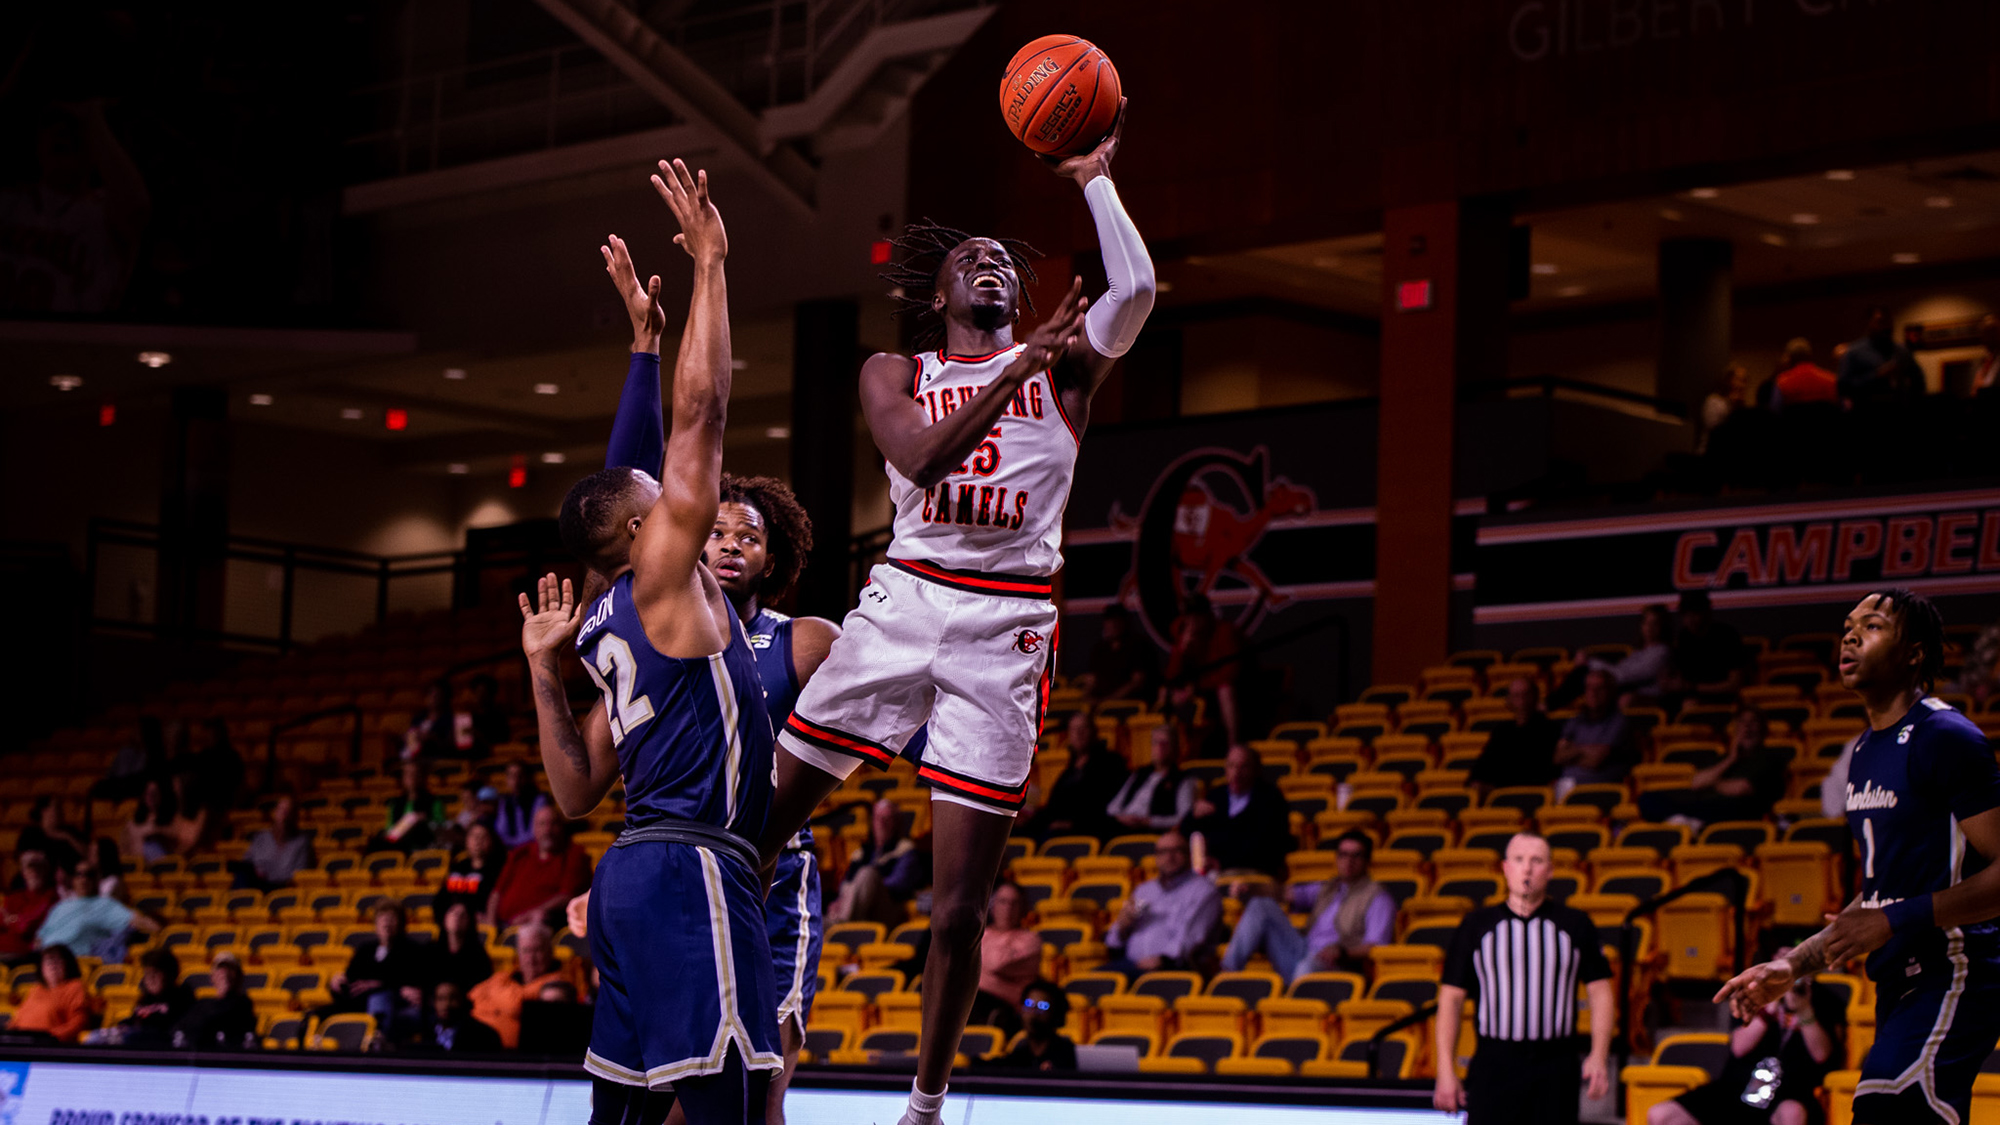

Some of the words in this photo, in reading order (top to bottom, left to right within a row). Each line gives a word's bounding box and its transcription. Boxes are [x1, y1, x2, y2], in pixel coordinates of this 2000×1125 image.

[1007, 56, 1061, 128] SPALDING
[1034, 83, 1078, 142] LEGACY
[921, 481, 1029, 532] CAMELS
